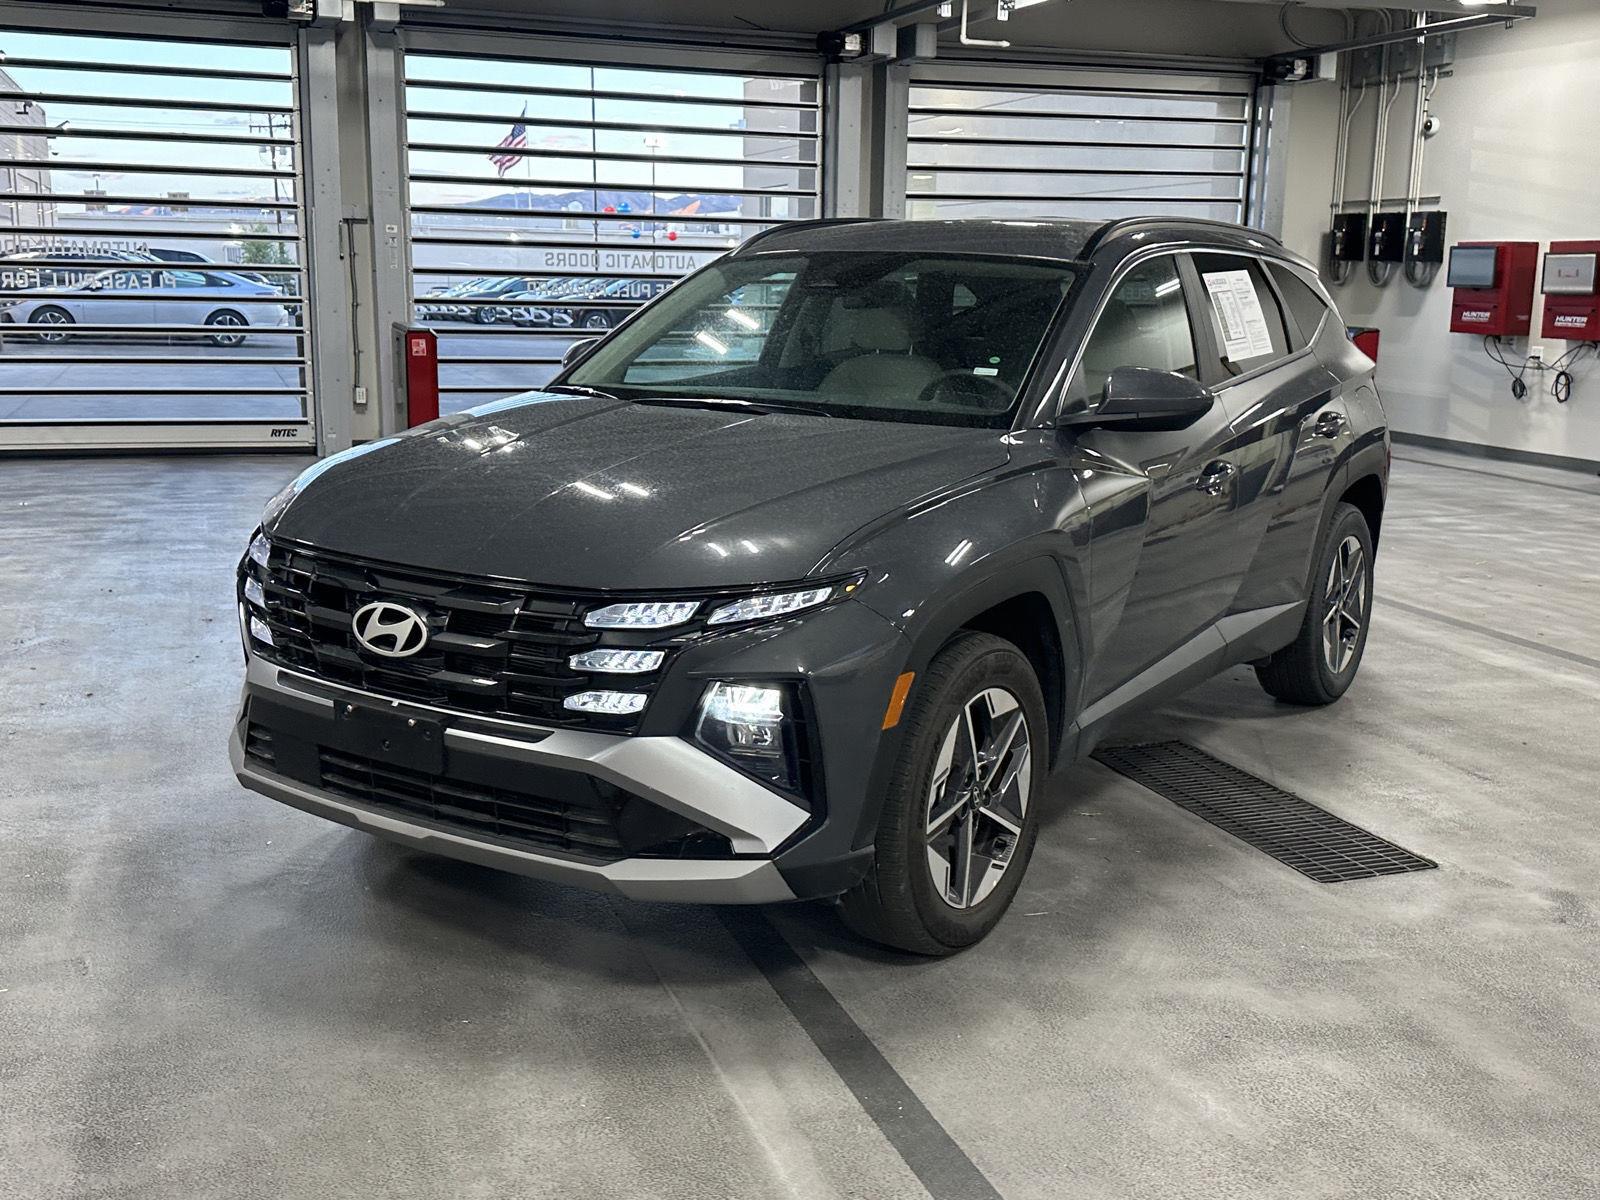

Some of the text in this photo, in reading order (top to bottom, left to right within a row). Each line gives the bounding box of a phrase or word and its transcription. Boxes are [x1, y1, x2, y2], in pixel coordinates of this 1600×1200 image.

[1462, 311, 1491, 319] HUNTER
[1556, 316, 1588, 324] HUNTER
[271, 429, 298, 437] RYTEC
